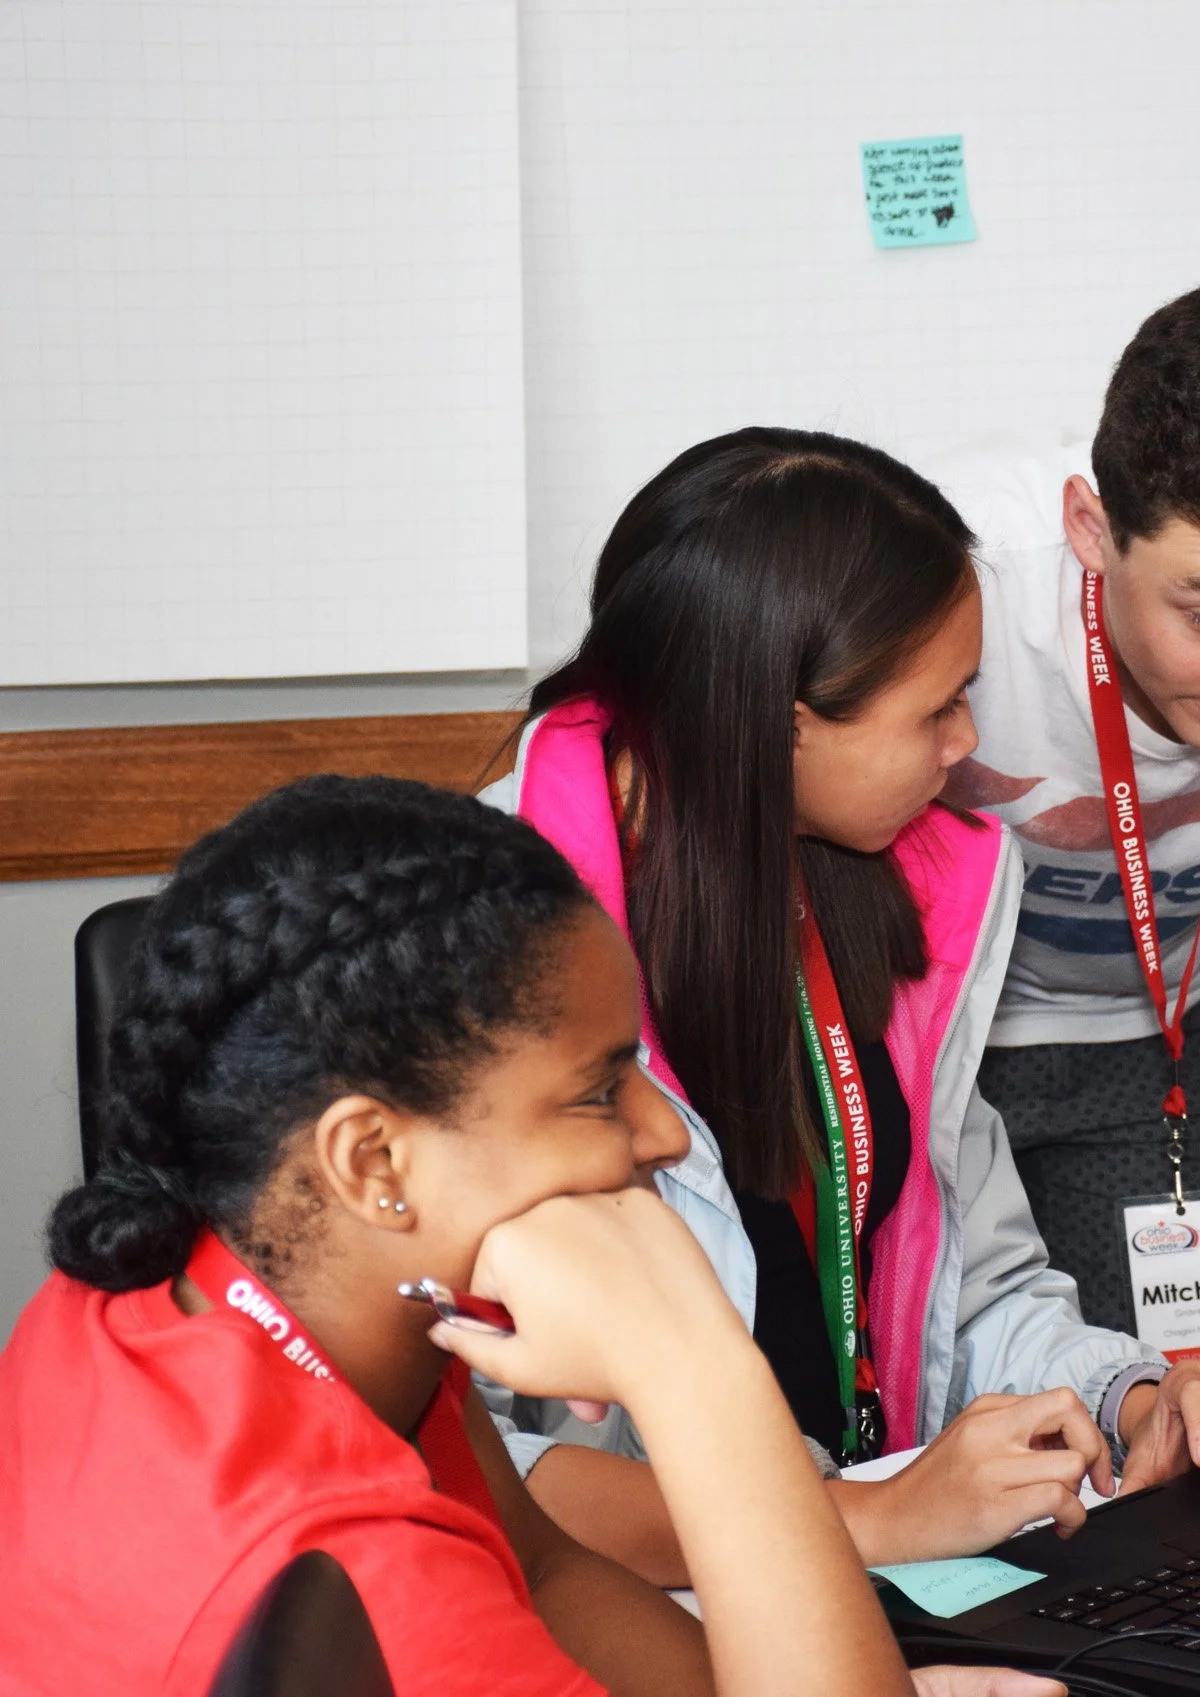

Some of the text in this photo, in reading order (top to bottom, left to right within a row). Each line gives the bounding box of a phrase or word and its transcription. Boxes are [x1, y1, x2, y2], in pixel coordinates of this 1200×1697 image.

[1086, 570, 1111, 686] SINESS WEEK
[1113, 782, 1158, 974] OHIO BUSINESS WEEK
[806, 1018, 823, 1061] HOUSING
[818, 1062, 839, 1129] RESIDENTIAL
[826, 1023, 869, 1236] OHIO BUSINESS WEEK
[832, 1139, 851, 1267] UNIVERSITY
[226, 1279, 290, 1341] OHIO
[842, 1275, 854, 1324] OHIO
